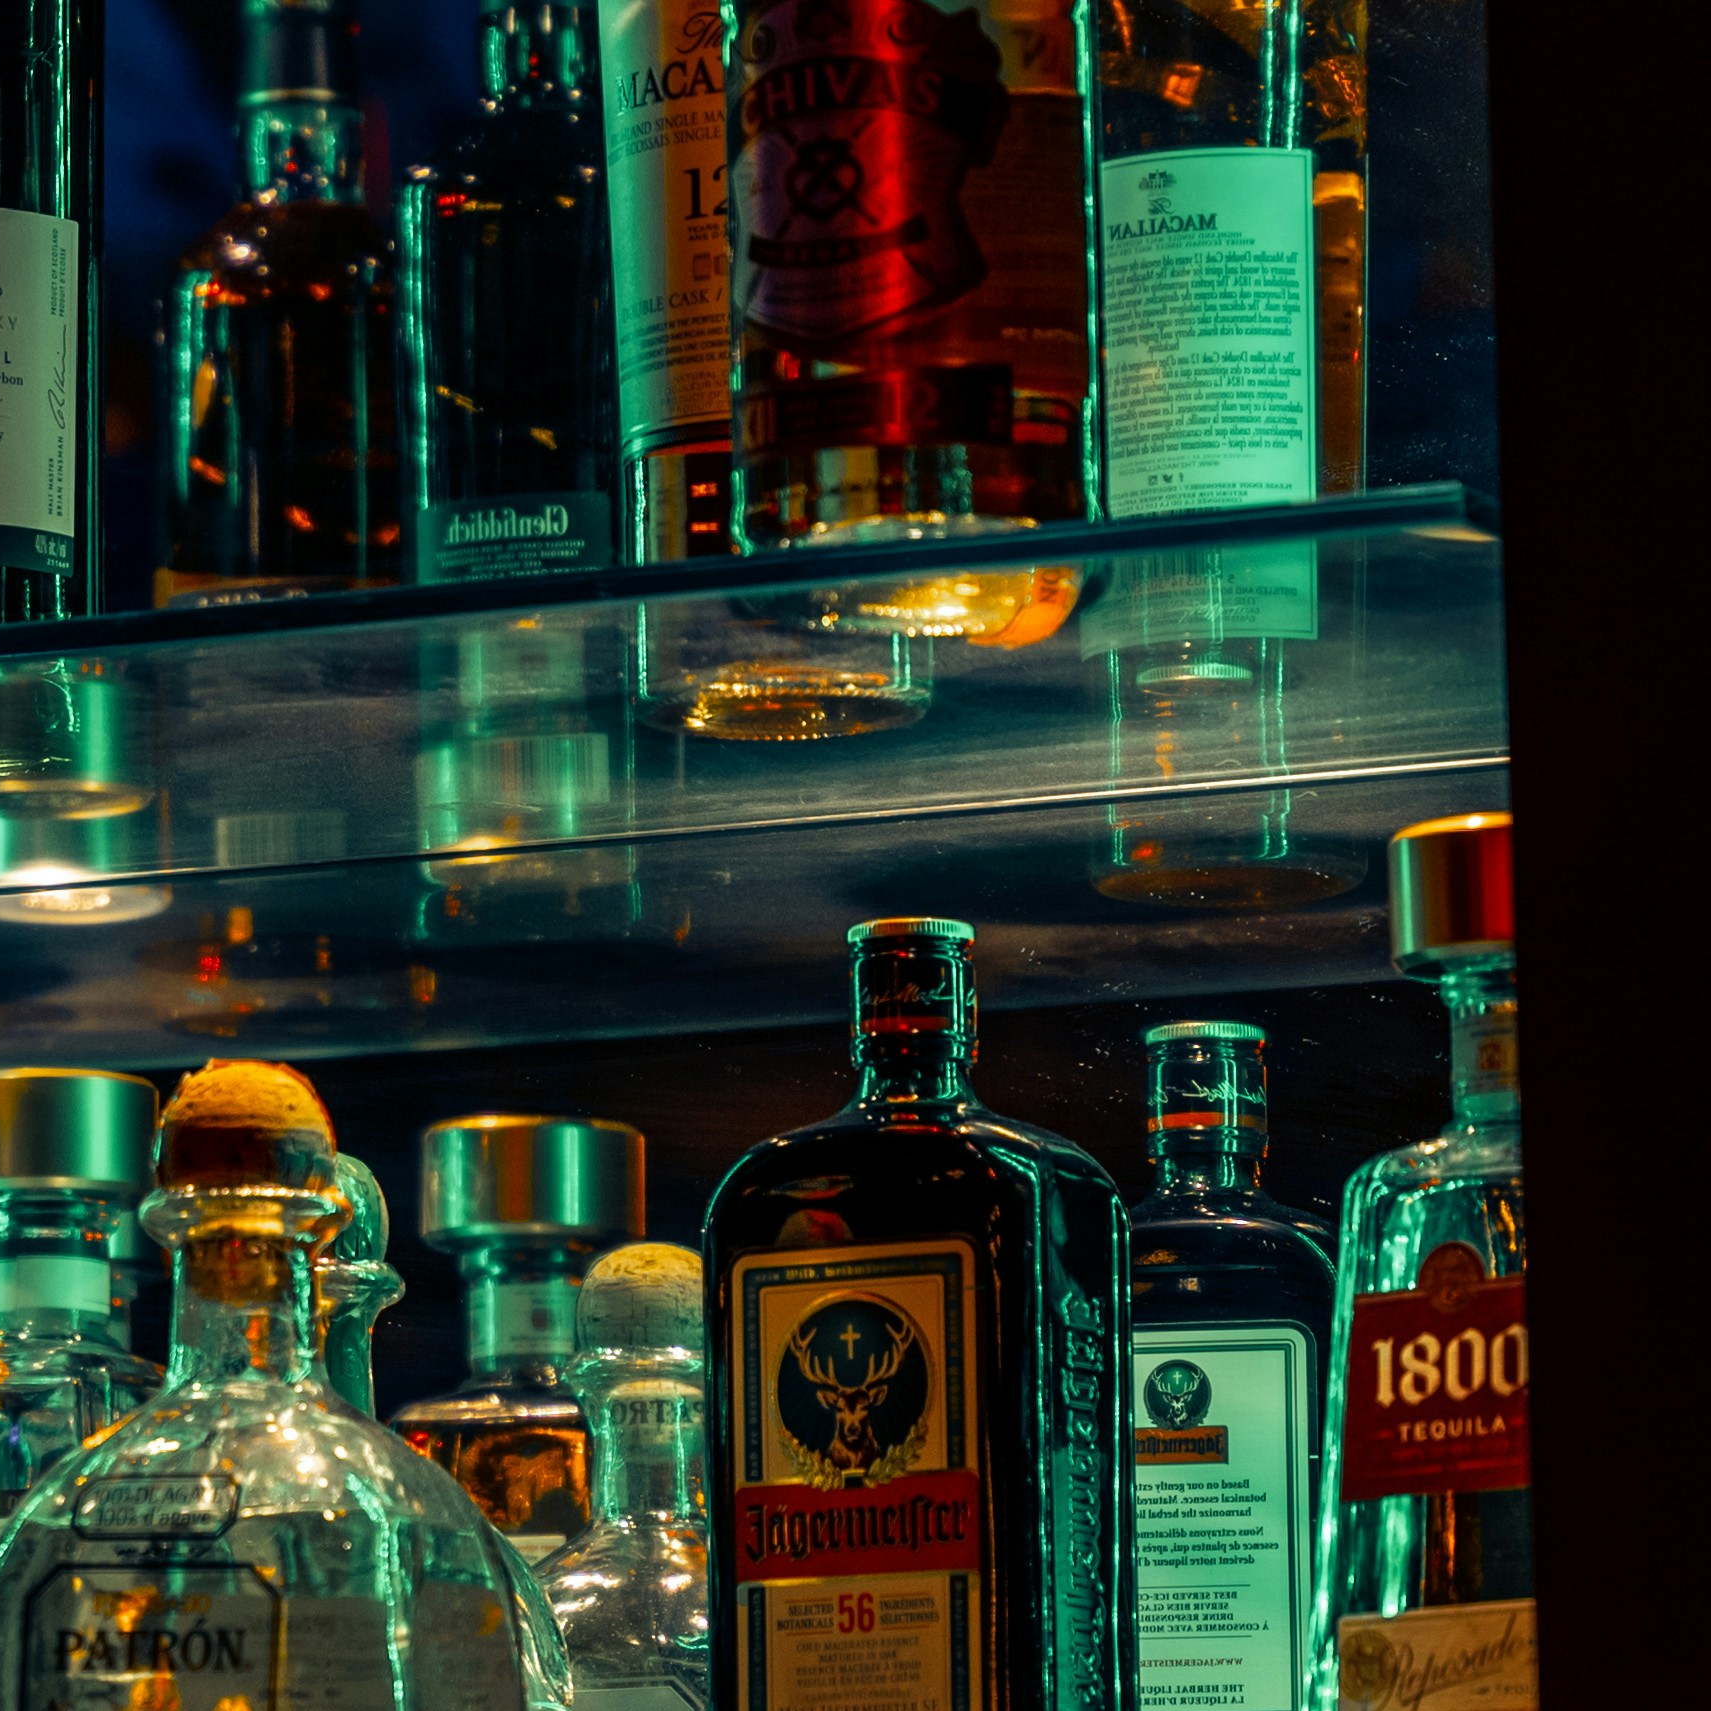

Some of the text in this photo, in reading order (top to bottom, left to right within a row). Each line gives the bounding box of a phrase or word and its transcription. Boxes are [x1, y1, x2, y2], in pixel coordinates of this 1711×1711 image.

[670, 288, 710, 310] CASK
[1370, 1319, 1529, 1409] 1800
[1396, 1413, 1509, 1445] TEQUILA
[744, 1488, 969, 1565] Jägermeister
[837, 1592, 876, 1635] 56
[54, 1618, 250, 1674] PATRÓN
